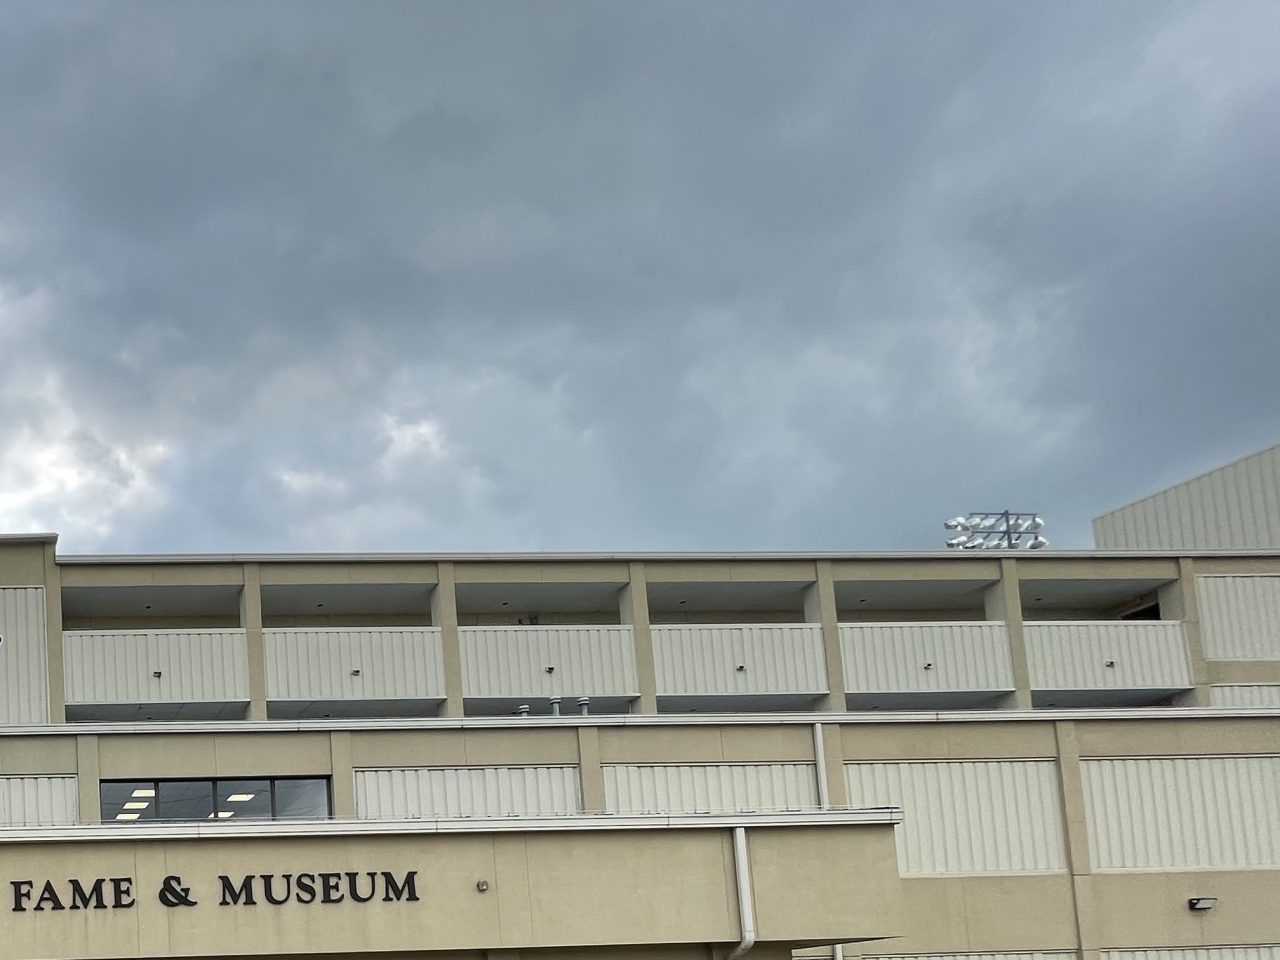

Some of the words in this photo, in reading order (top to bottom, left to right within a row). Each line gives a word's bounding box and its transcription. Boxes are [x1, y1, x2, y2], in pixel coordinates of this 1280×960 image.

[10, 877, 136, 913] FAME
[158, 875, 197, 908] &
[219, 870, 420, 906] MUSEUM
